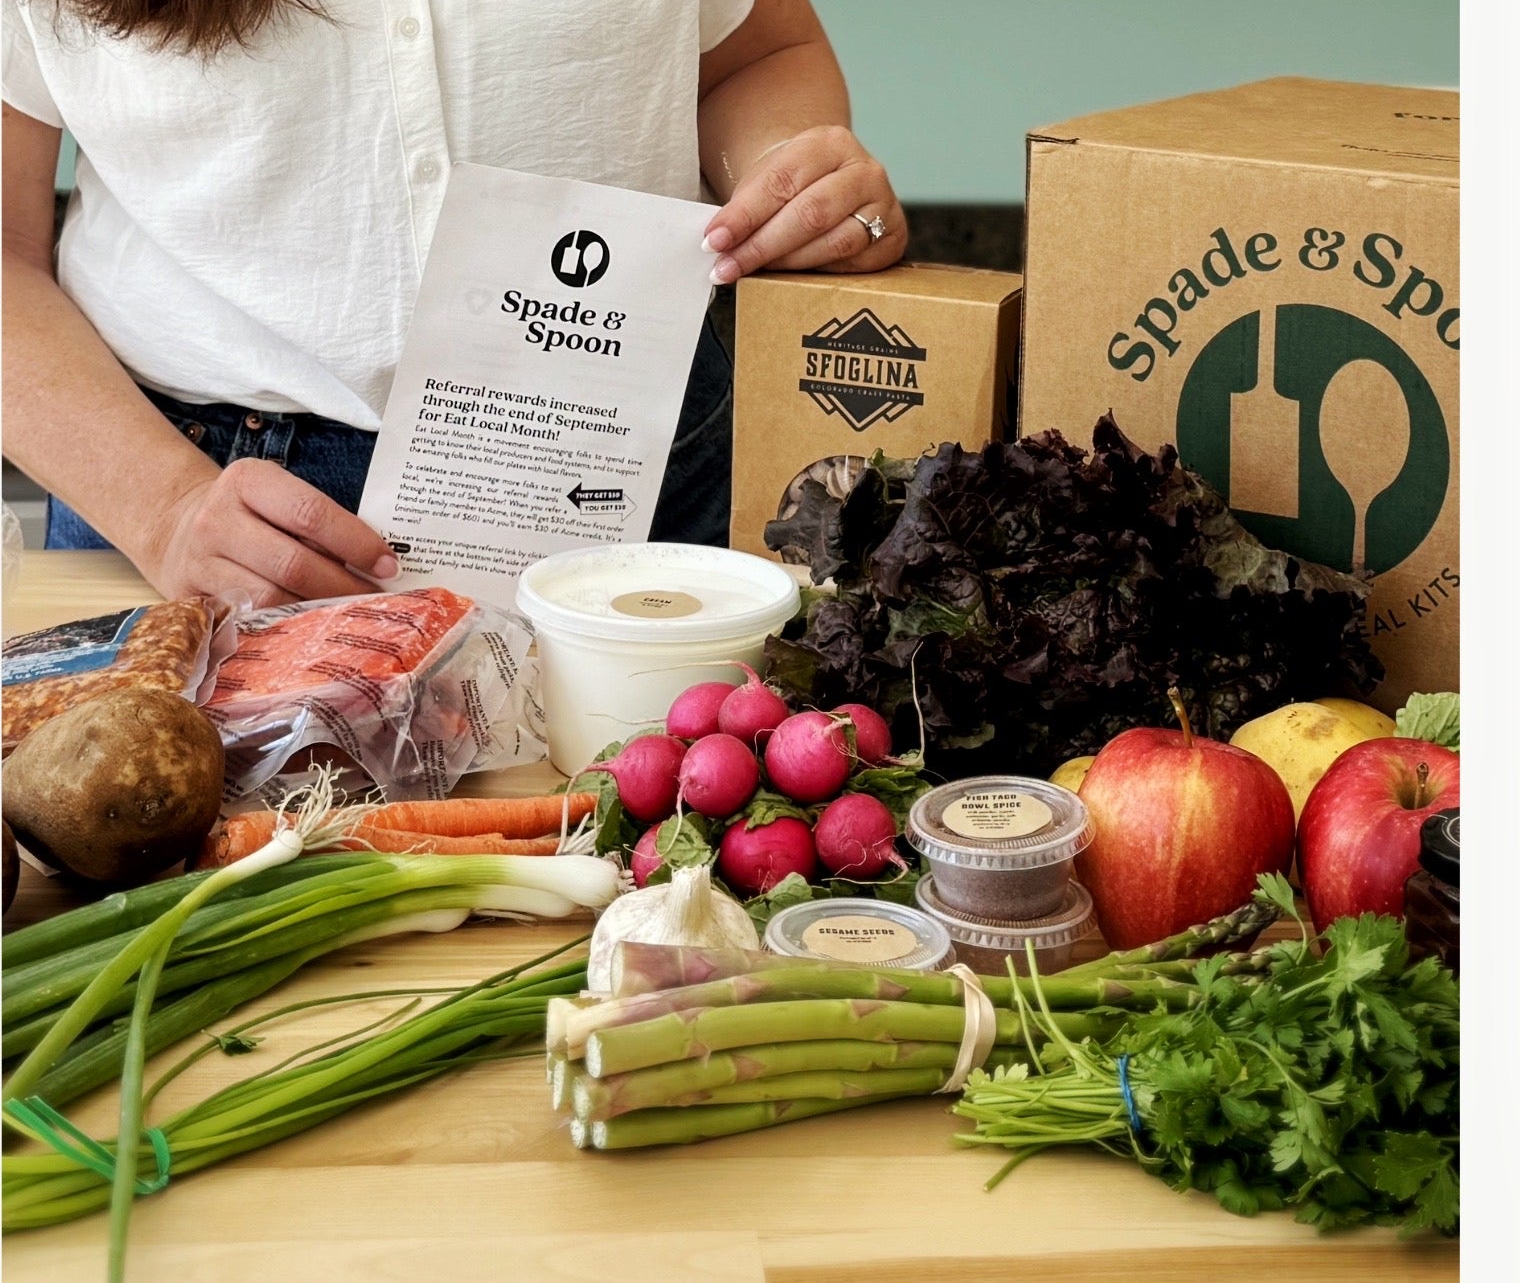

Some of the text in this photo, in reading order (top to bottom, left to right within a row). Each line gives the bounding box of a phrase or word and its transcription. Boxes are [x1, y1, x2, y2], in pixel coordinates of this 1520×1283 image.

[500, 290, 627, 330] Spade &
[1107, 227, 1282, 382] Spade
[1298, 227, 1346, 271] &
[525, 320, 622, 357] Spoon
[806, 352, 918, 389] SFOGLINA
[422, 393, 630, 435] through the end of September
[424, 378, 617, 418] Referral rewards increased
[417, 407, 560, 440] for Eat Local Month!
[1407, 567, 1460, 618] KITS
